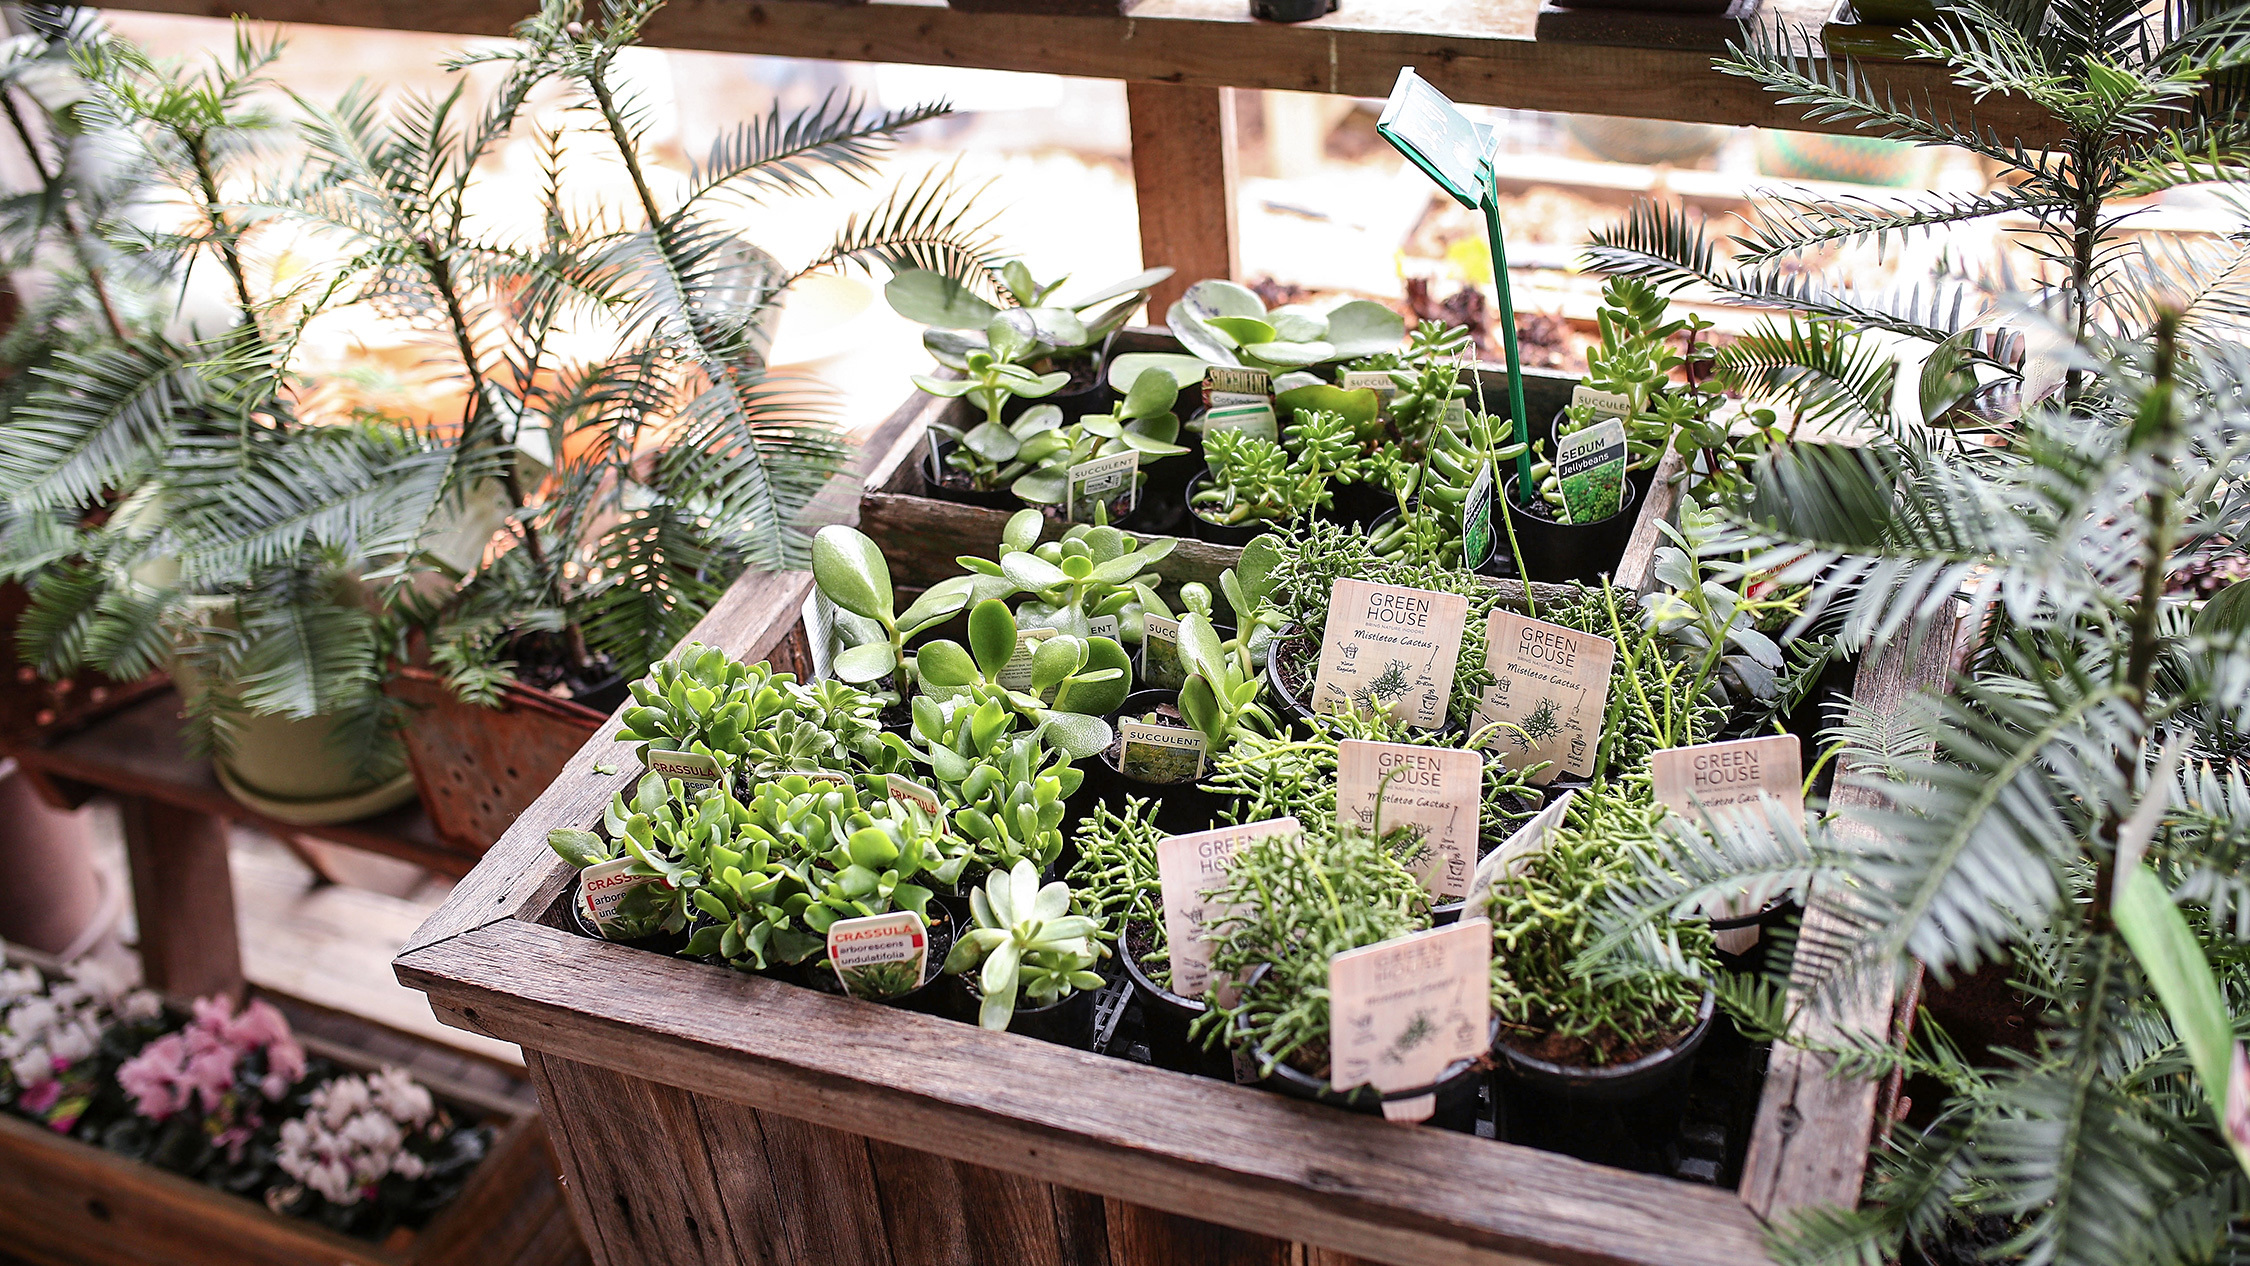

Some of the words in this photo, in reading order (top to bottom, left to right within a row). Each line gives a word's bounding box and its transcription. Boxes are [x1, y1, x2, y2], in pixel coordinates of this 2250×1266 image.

[1210, 370, 1268, 394] SUCCULENT
[1350, 379, 1394, 387] SUCCUL
[1579, 396, 1631, 410] SUCCULEN
[1562, 438, 1605, 462] SEDUM
[1075, 458, 1133, 479] SUCCULENT
[1562, 453, 1609, 476] Jellybeans
[1370, 592, 1430, 613] GREEN
[1366, 607, 1428, 628] HOUSE
[1354, 629, 1398, 644] Mistletoe
[1400, 636, 1433, 649] Cactus
[1521, 627, 1577, 652] GREEN
[1518, 641, 1576, 668] HOUSE
[1506, 662, 1548, 681] Mistletoe
[1549, 674, 1580, 691] Cactus
[1130, 731, 1200, 747] SUCCULENT
[653, 762, 716, 777] CRASSULA
[1378, 753, 1441, 772] GREEN
[1693, 750, 1759, 771] GREEN
[1378, 768, 1441, 787] HOUSE
[1694, 765, 1761, 786] HOUSE
[1367, 792, 1413, 805] Mstletoe
[1416, 797, 1450, 809] Cactus
[587, 873, 641, 892] CRASS
[594, 891, 627, 906] arbore
[835, 925, 913, 943] CRASSULA
[840, 940, 904, 954] arborescens
[841, 951, 905, 965] undulatifolia
